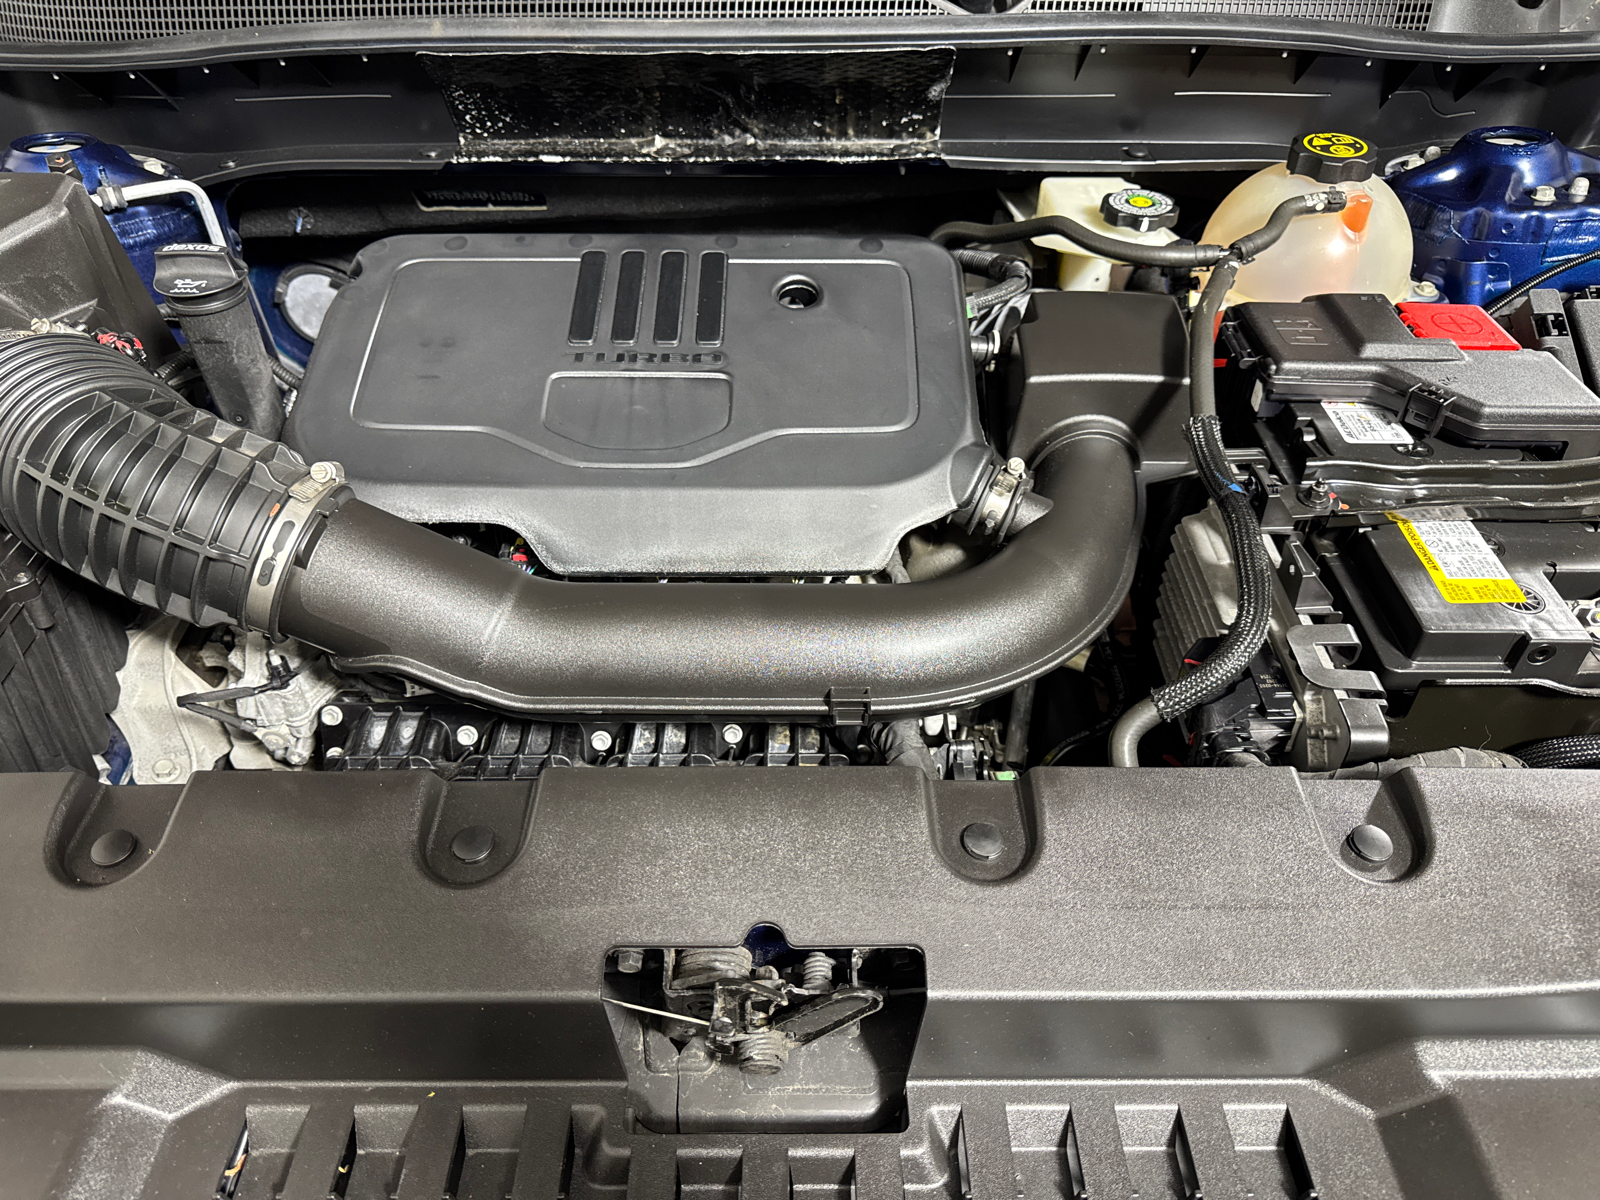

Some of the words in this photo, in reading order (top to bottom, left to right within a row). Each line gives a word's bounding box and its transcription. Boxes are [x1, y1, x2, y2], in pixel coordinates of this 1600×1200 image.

[162, 243, 222, 252] dexos
[566, 352, 723, 364] TURBO
[1414, 542, 1435, 565] DANGER
